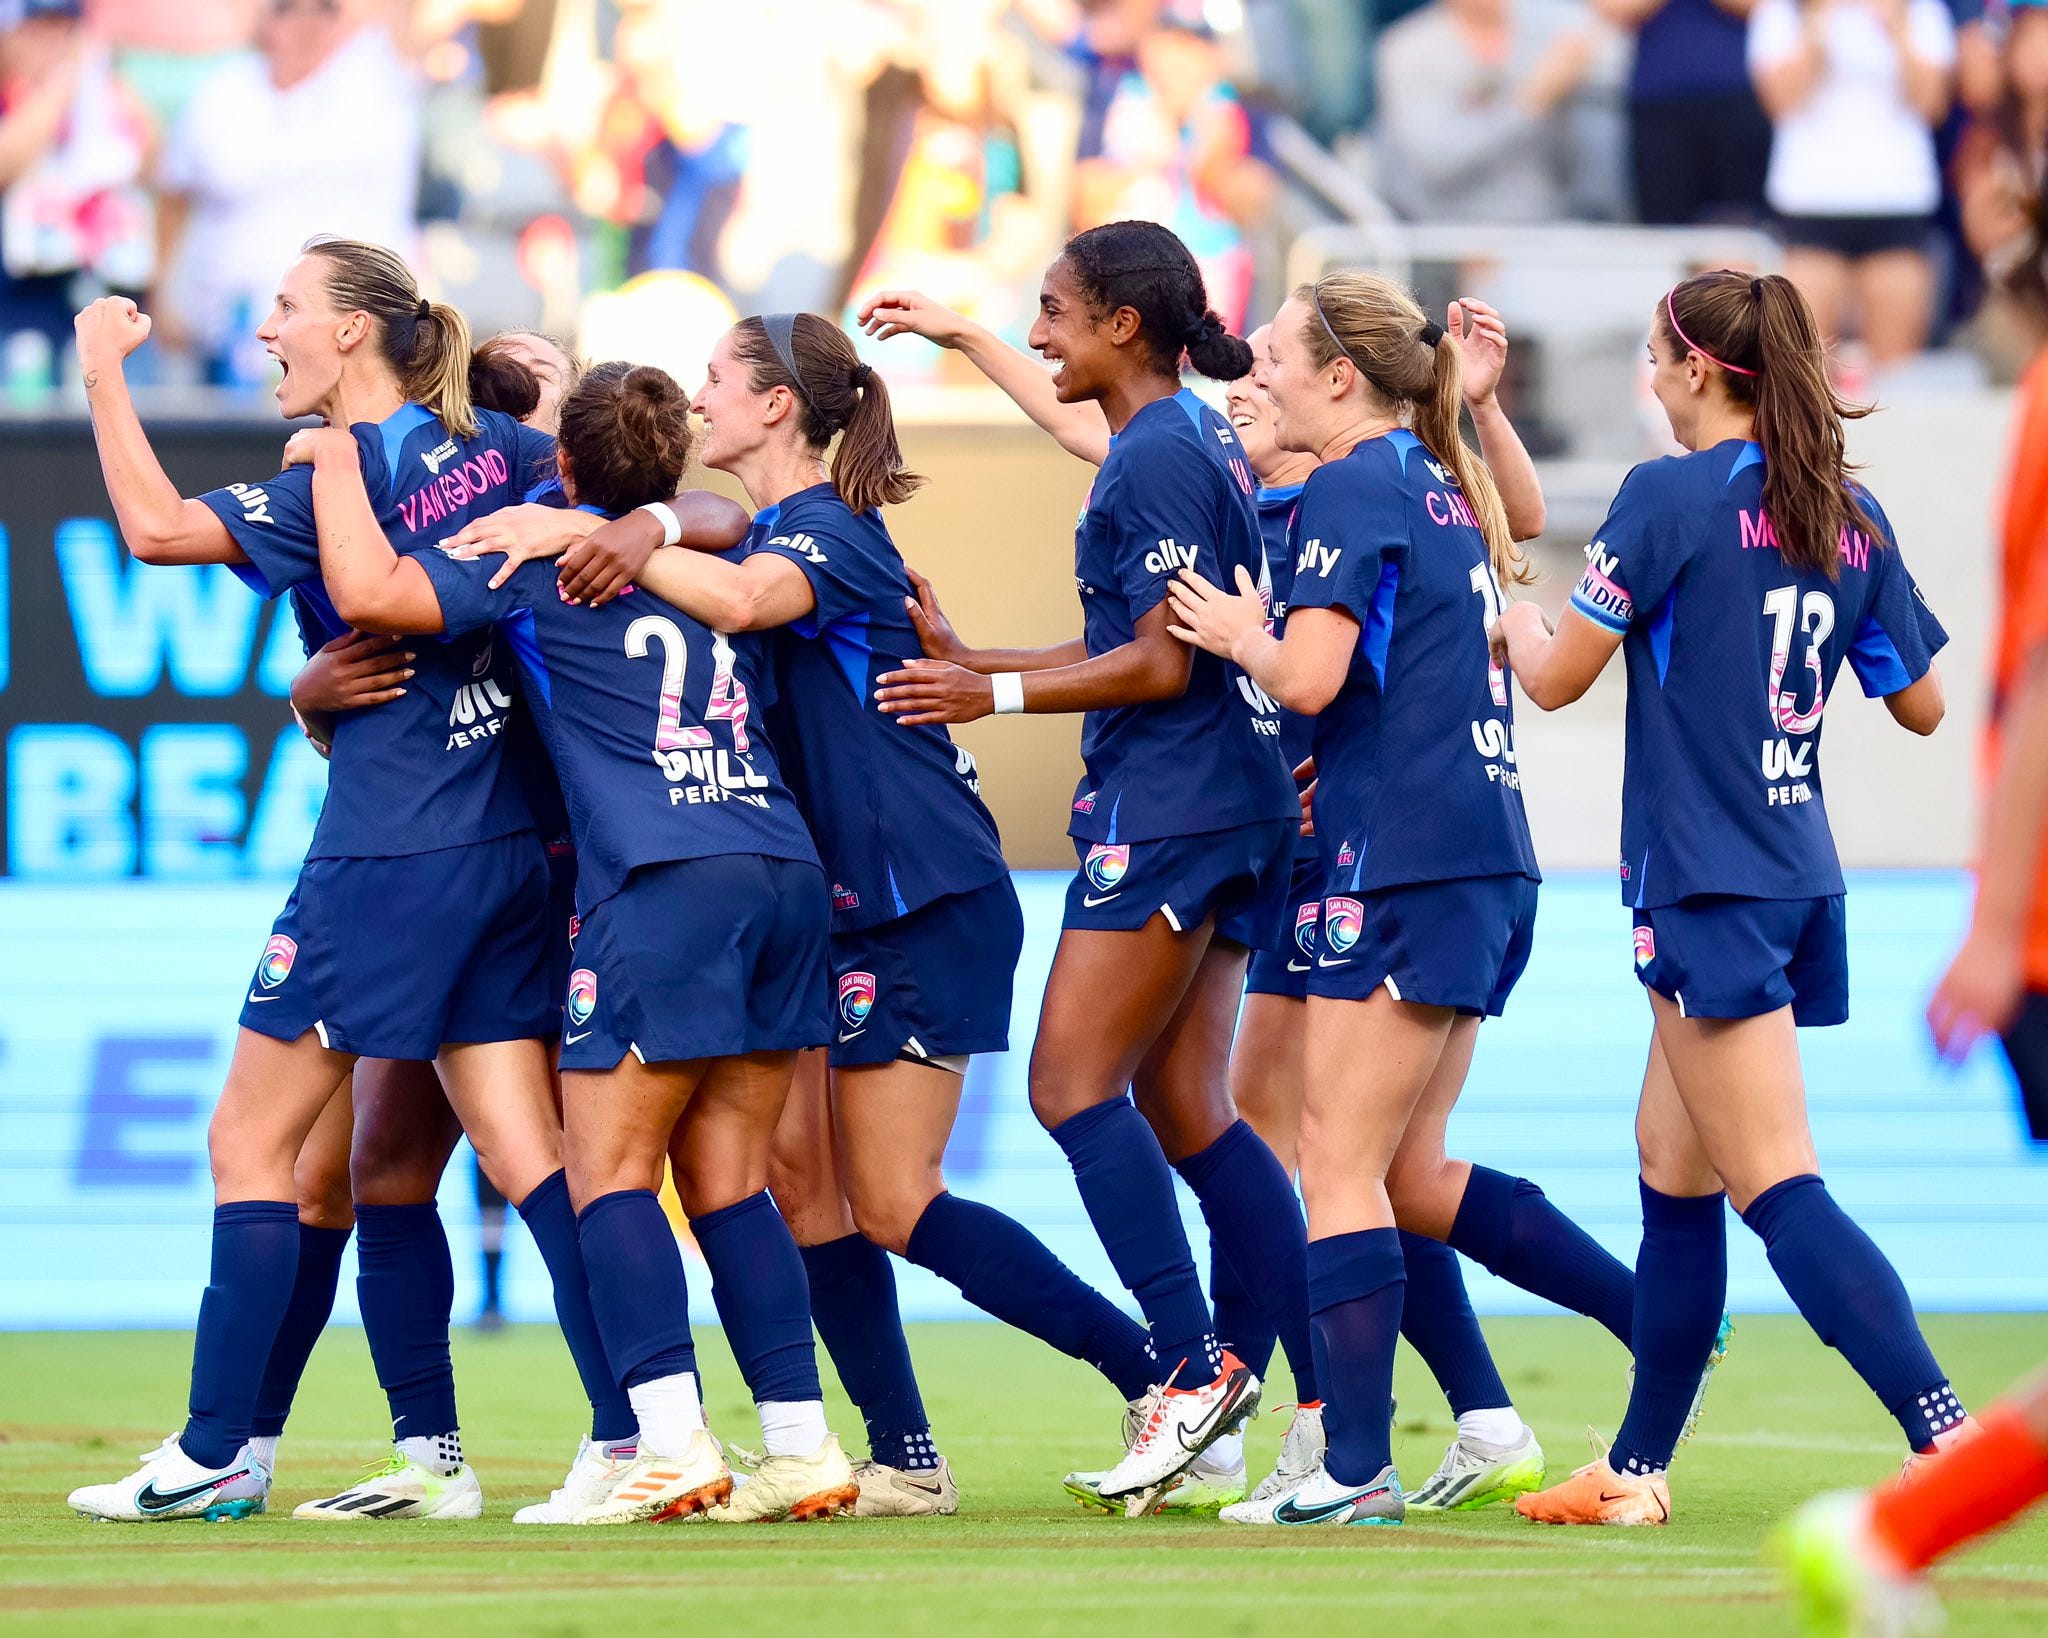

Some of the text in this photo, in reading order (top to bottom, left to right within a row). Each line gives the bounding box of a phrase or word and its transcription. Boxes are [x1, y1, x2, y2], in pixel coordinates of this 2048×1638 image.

[224, 482, 275, 524] ally
[397, 481, 447, 533] VAN
[767, 533, 828, 563] ally
[1144, 538, 1198, 573] ally
[1738, 508, 1870, 572] MAN
[54, 517, 305, 698] W
[1468, 560, 1509, 706] 1
[623, 614, 751, 754] 24
[1762, 584, 1835, 735] 13
[1329, 900, 1361, 917] SAN DIEGO
[841, 975, 873, 991] SAN DIEGO
